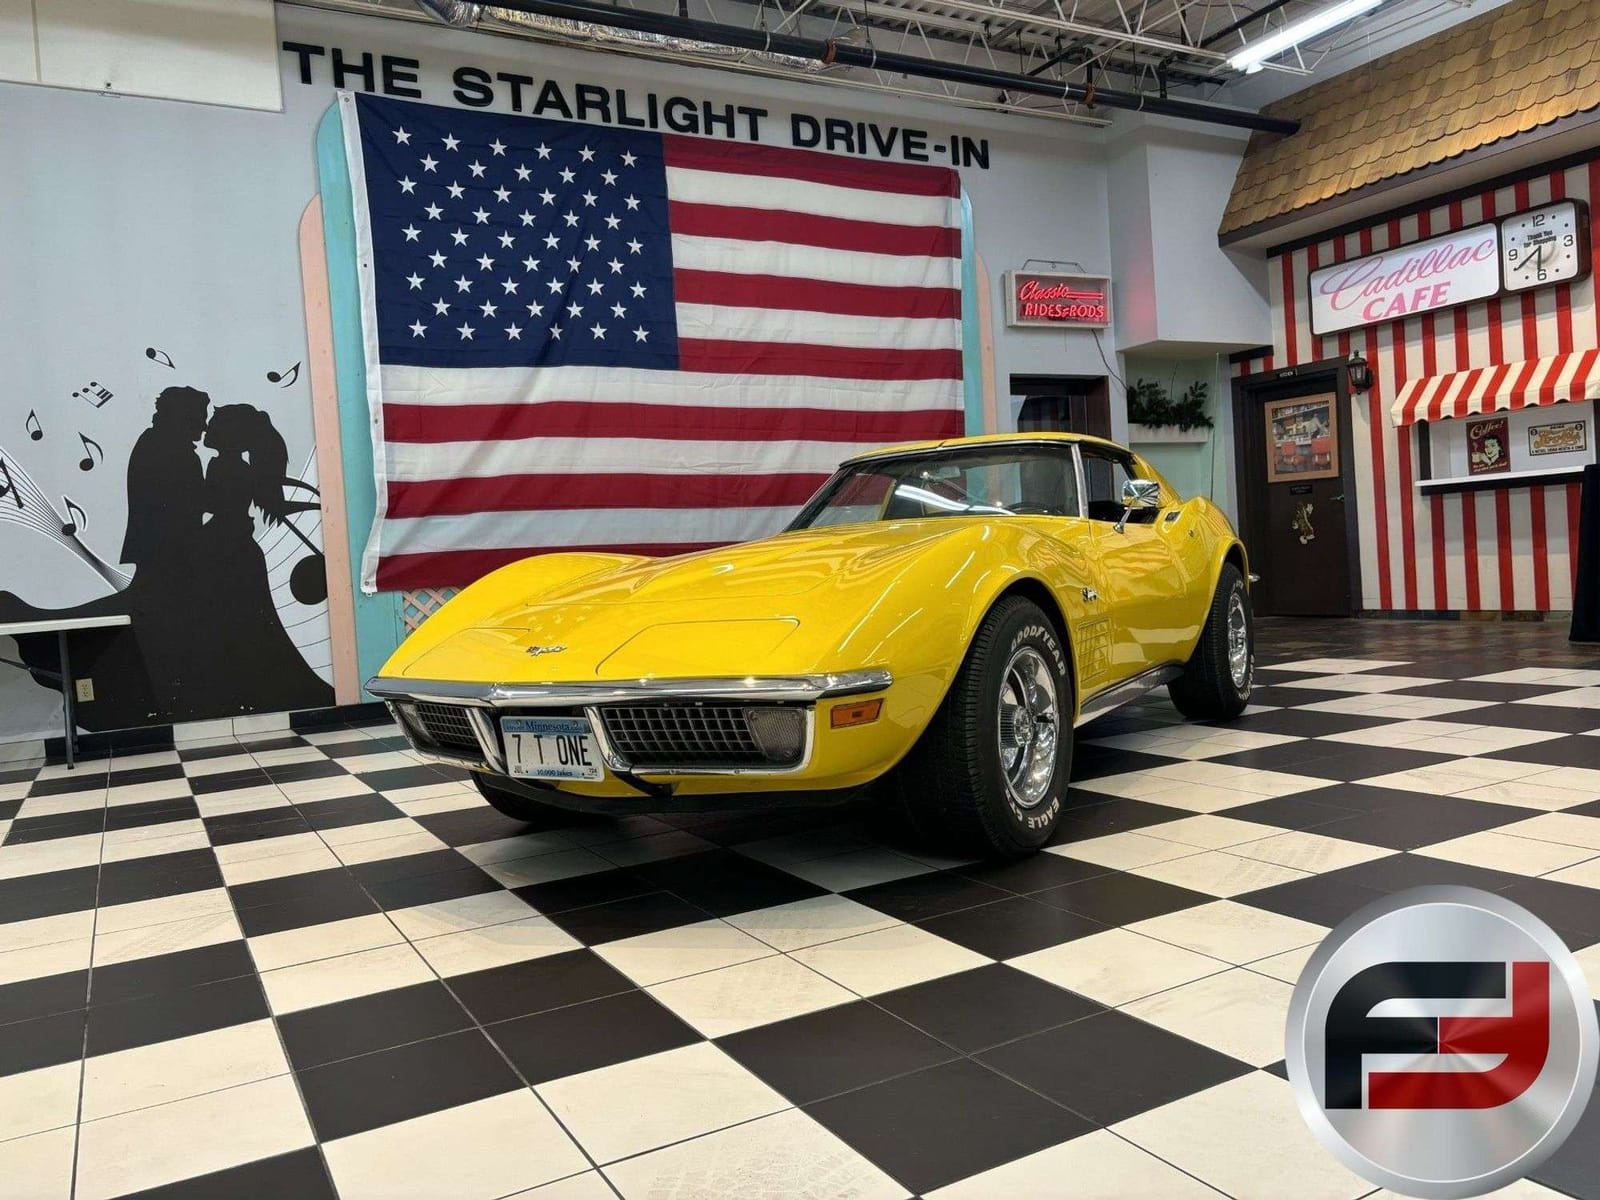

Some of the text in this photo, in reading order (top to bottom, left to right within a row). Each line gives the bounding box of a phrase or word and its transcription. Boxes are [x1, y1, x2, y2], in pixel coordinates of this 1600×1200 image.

[283, 42, 990, 169] THE STARLIGHT DRIVE-IN
[1532, 214, 1545, 227] 12
[1563, 234, 1574, 247] 3
[1508, 248, 1518, 261] 9
[1320, 238, 1495, 311] Cadillac
[1537, 268, 1547, 281] 6
[1020, 280, 1069, 300] Classic
[1025, 302, 1062, 317] RIDES
[1069, 304, 1104, 318] RODS
[1362, 281, 1451, 321] CAFE
[525, 719, 570, 731] Minnesota
[511, 733, 593, 766] 7 T ONE
[1028, 796, 1060, 829] EAGLE
